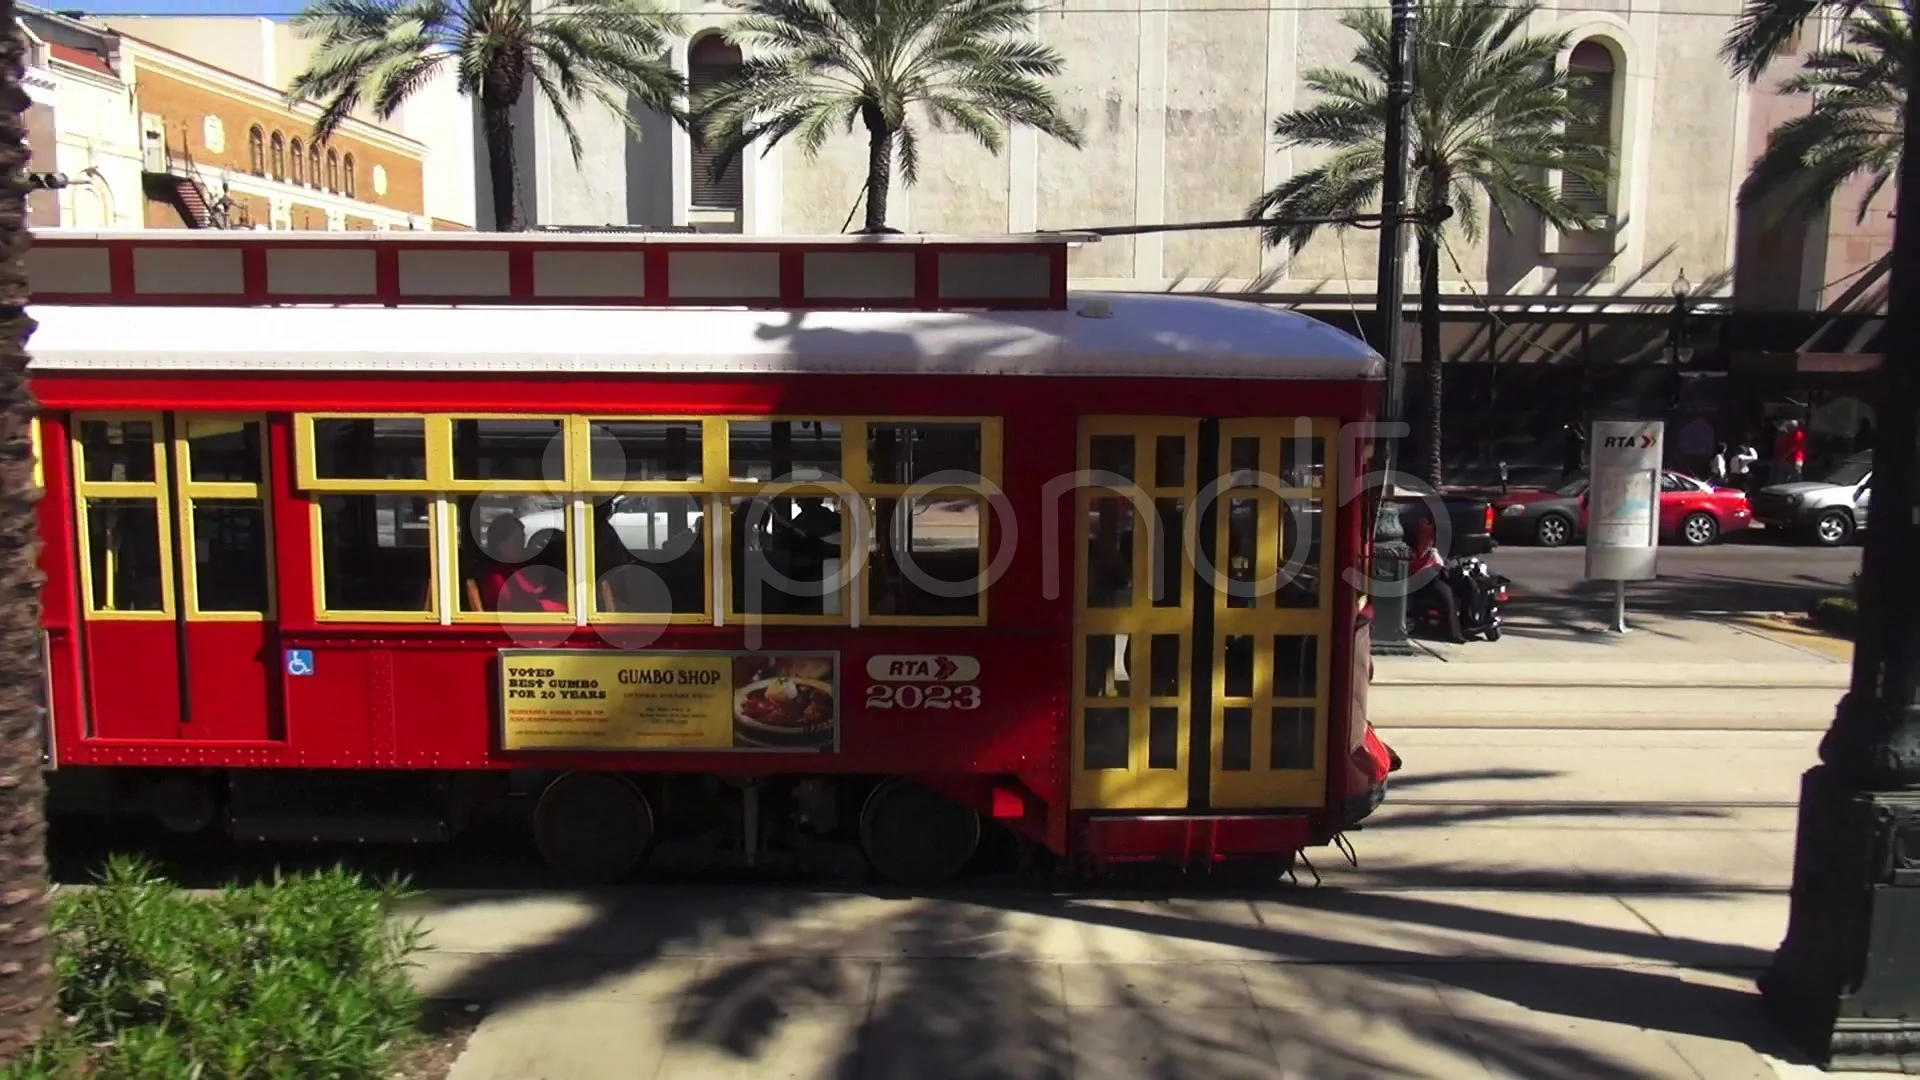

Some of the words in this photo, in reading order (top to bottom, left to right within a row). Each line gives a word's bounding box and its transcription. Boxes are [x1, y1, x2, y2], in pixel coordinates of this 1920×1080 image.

[1604, 436, 1636, 448] RTA
[508, 668, 555, 678] VOTED
[888, 660, 930, 676] RTA
[617, 669, 675, 685] GUMBO
[677, 669, 721, 685] SHOP
[508, 679, 545, 688] BEST
[549, 679, 599, 688] GUMBO
[508, 689, 537, 699] FOR
[540, 690, 556, 699] 20
[560, 690, 607, 699] YEARS
[865, 684, 982, 710] 2023
